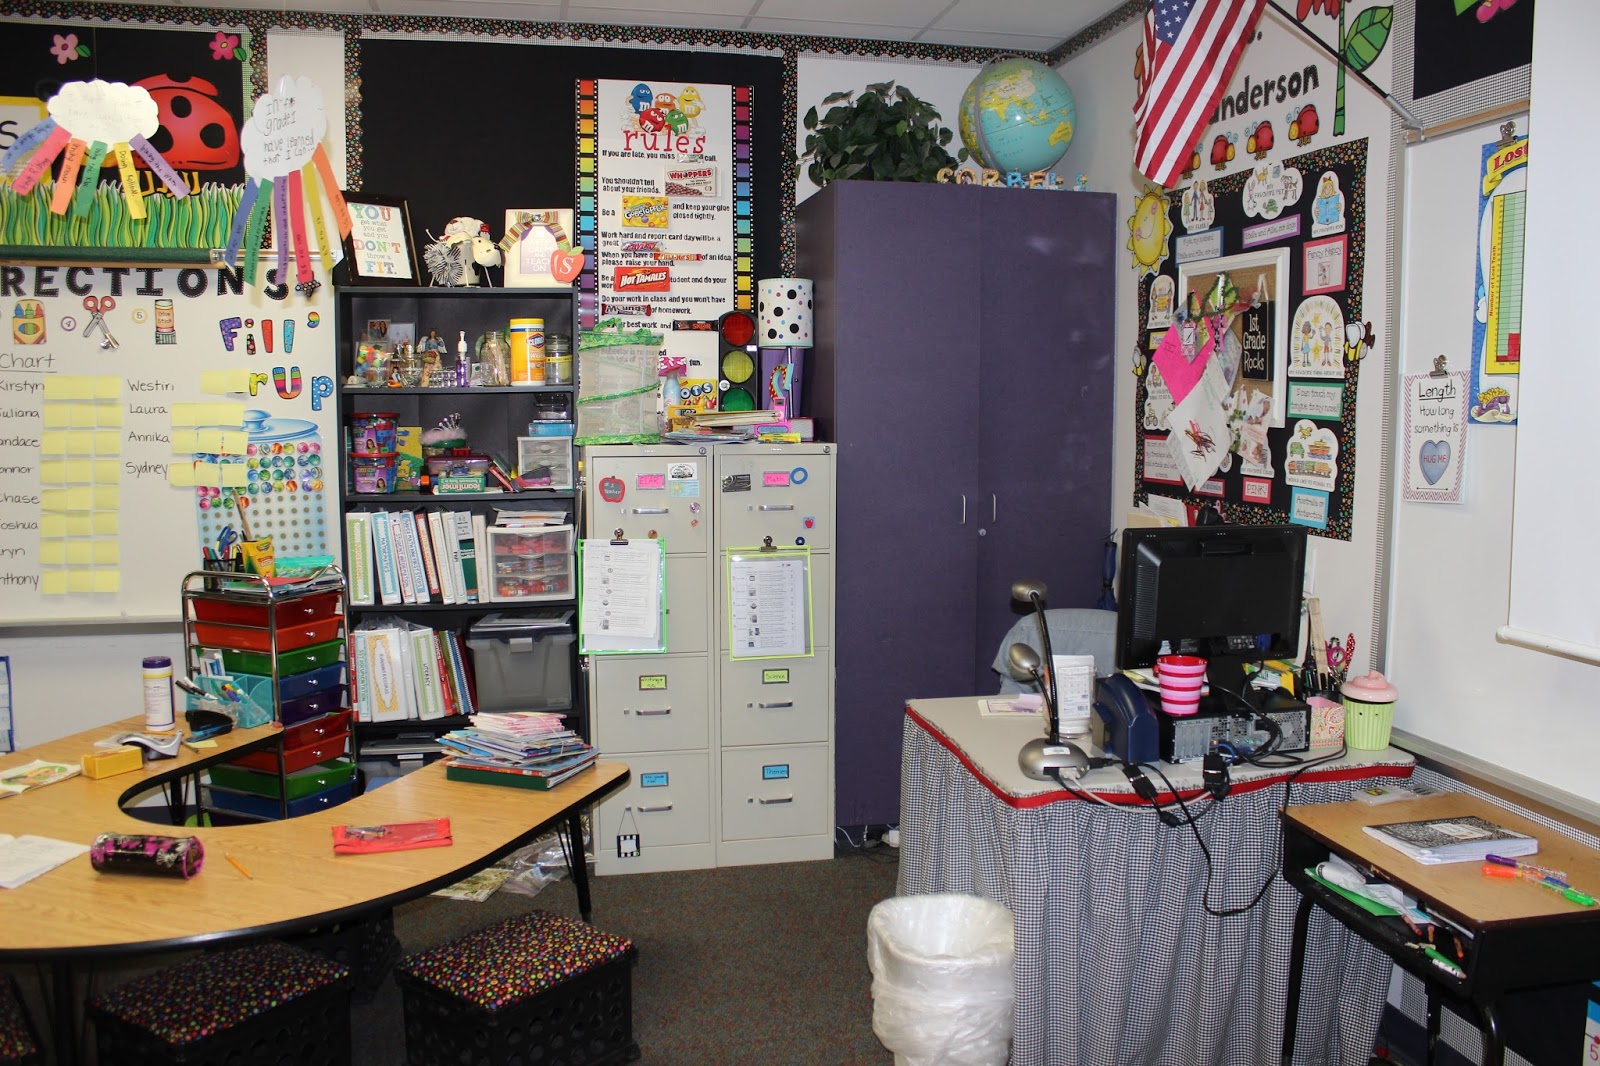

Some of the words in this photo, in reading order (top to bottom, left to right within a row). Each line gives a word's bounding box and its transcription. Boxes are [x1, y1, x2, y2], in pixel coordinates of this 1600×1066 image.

[623, 124, 706, 154] rules
[669, 169, 712, 179] WHOPPERS
[351, 203, 391, 221] YOU
[686, 203, 700, 211] keep
[717, 204, 730, 212] glue
[619, 231, 634, 239] hard
[684, 234, 696, 242] day
[352, 238, 401, 254] DON'T
[702, 253, 708, 261] of
[533, 264, 546, 272] ON
[559, 256, 575, 275] S
[0, 267, 289, 300] RECTIONS
[620, 275, 637, 287] HOT
[636, 271, 667, 284] TAMALES
[1248, 314, 1259, 332] 1st
[1243, 332, 1266, 350] Grade
[1243, 351, 1265, 372] Rocks
[128, 378, 174, 392] Westin
[680, 382, 713, 399] OTS
[1418, 379, 1456, 402] Length
[129, 403, 168, 415] Laura
[1420, 405, 1437, 416] How
[1438, 406, 1454, 419] long
[128, 430, 170, 444] Annika
[1414, 421, 1452, 437] something
[1453, 422, 1459, 432] is
[1423, 454, 1437, 463] HUG
[1437, 454, 1447, 462] ME
[125, 461, 168, 479] Sydney
[0, 521, 39, 530] oshua
